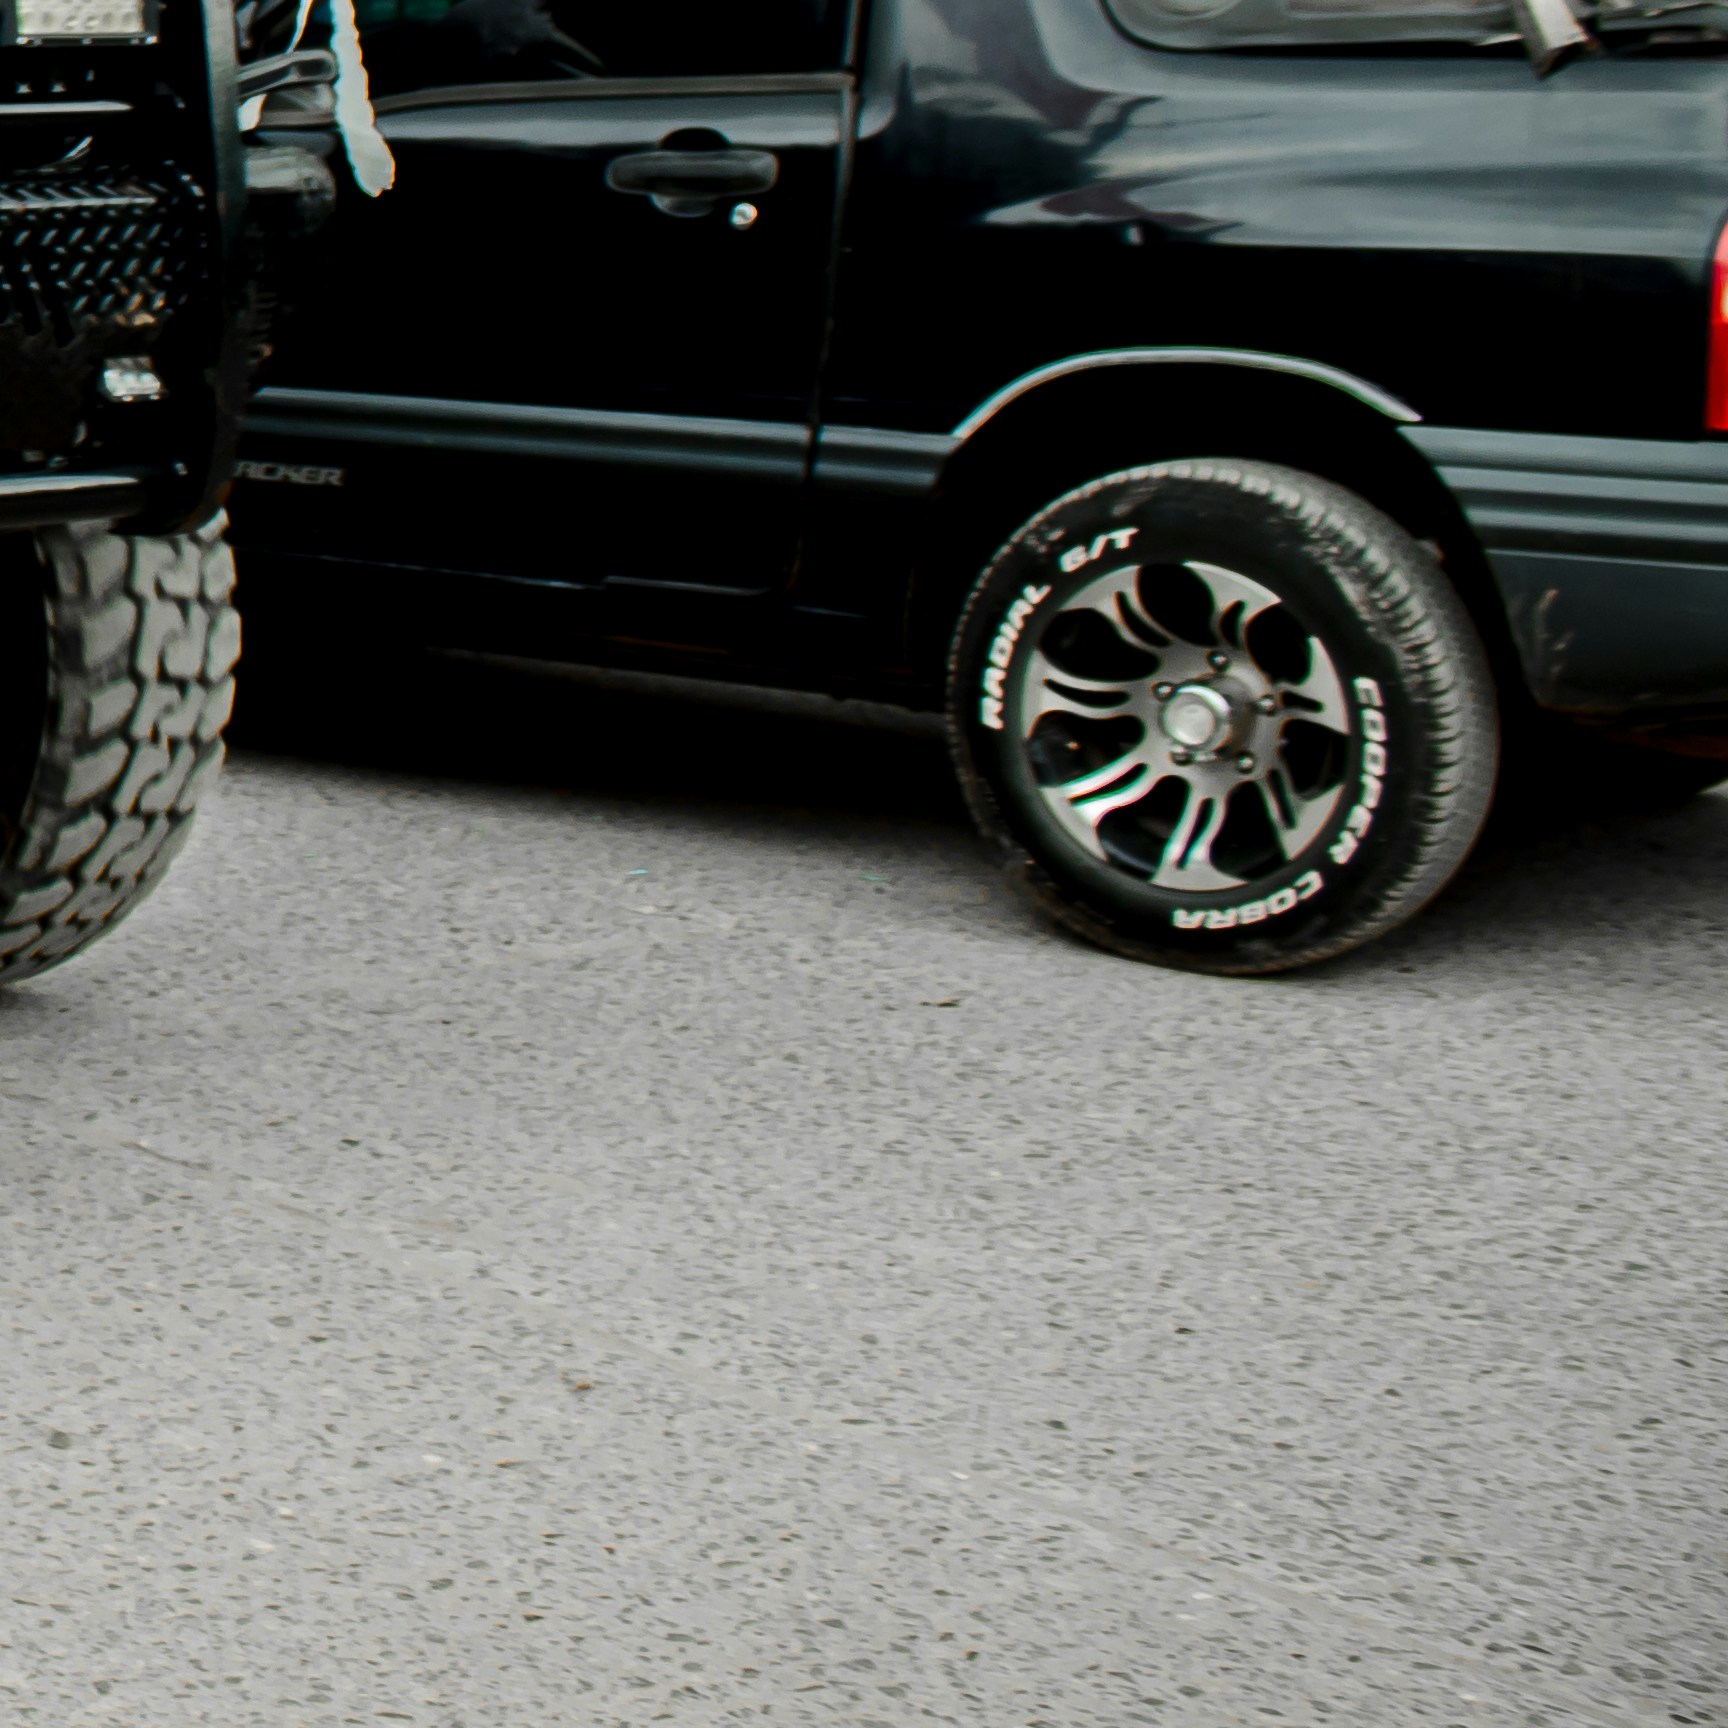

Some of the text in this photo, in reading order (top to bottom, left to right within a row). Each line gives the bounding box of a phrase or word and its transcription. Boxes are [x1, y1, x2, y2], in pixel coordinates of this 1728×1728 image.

[981, 583, 1052, 732] RADIAL
[1325, 676, 1388, 865] COOPER
[1172, 870, 1325, 930] COBRA
